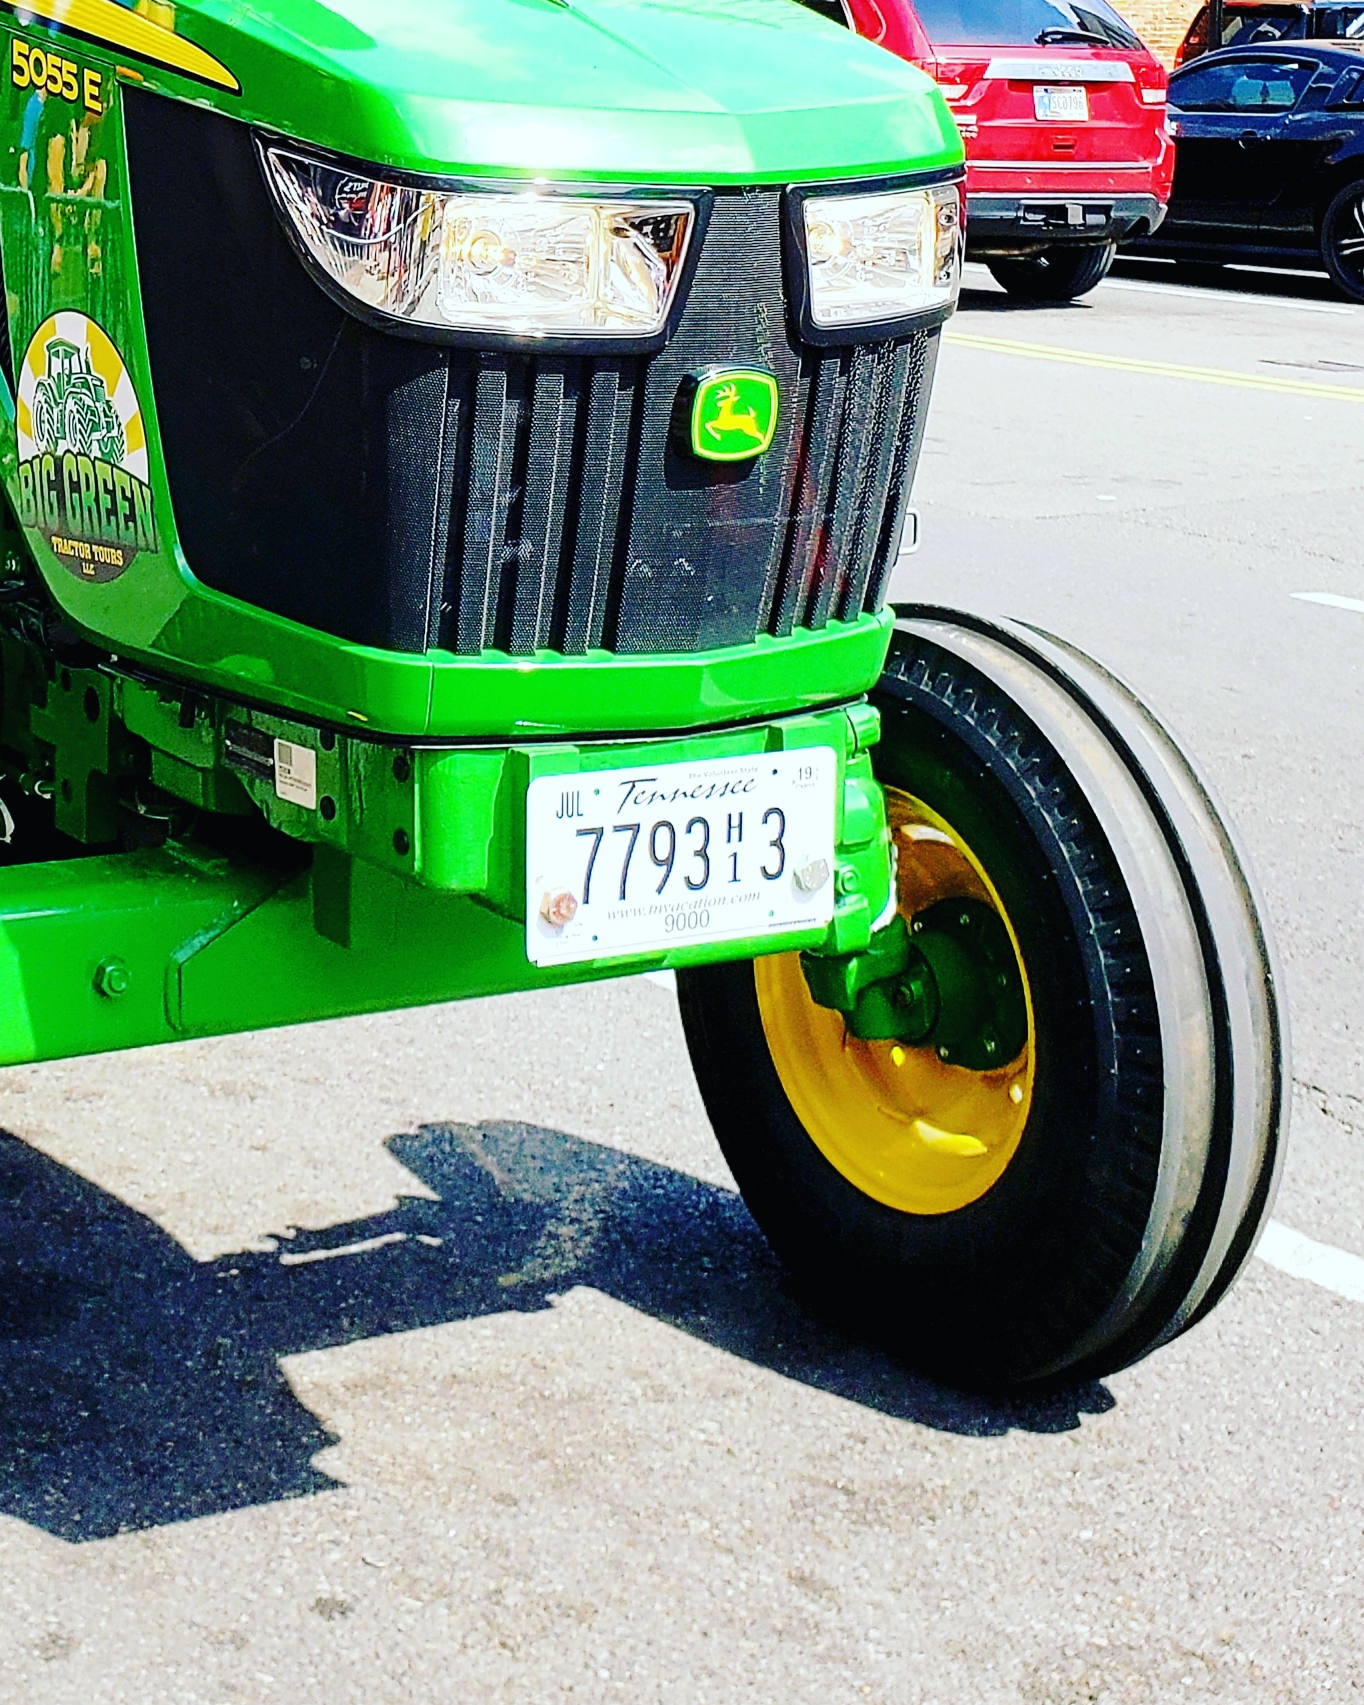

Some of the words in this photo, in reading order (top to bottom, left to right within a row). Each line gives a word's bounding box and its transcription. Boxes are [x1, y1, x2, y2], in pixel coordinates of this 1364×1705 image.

[18, 453, 60, 530] BIG
[61, 451, 159, 553] GREEN
[50, 535, 92, 561] TRACTOR
[92, 544, 124, 567] TOURS
[81, 561, 96, 575] LLC
[796, 765, 813, 781] 19
[556, 790, 584, 819] JUL
[617, 777, 758, 814] Tennessee
[664, 909, 710, 934] 9000
